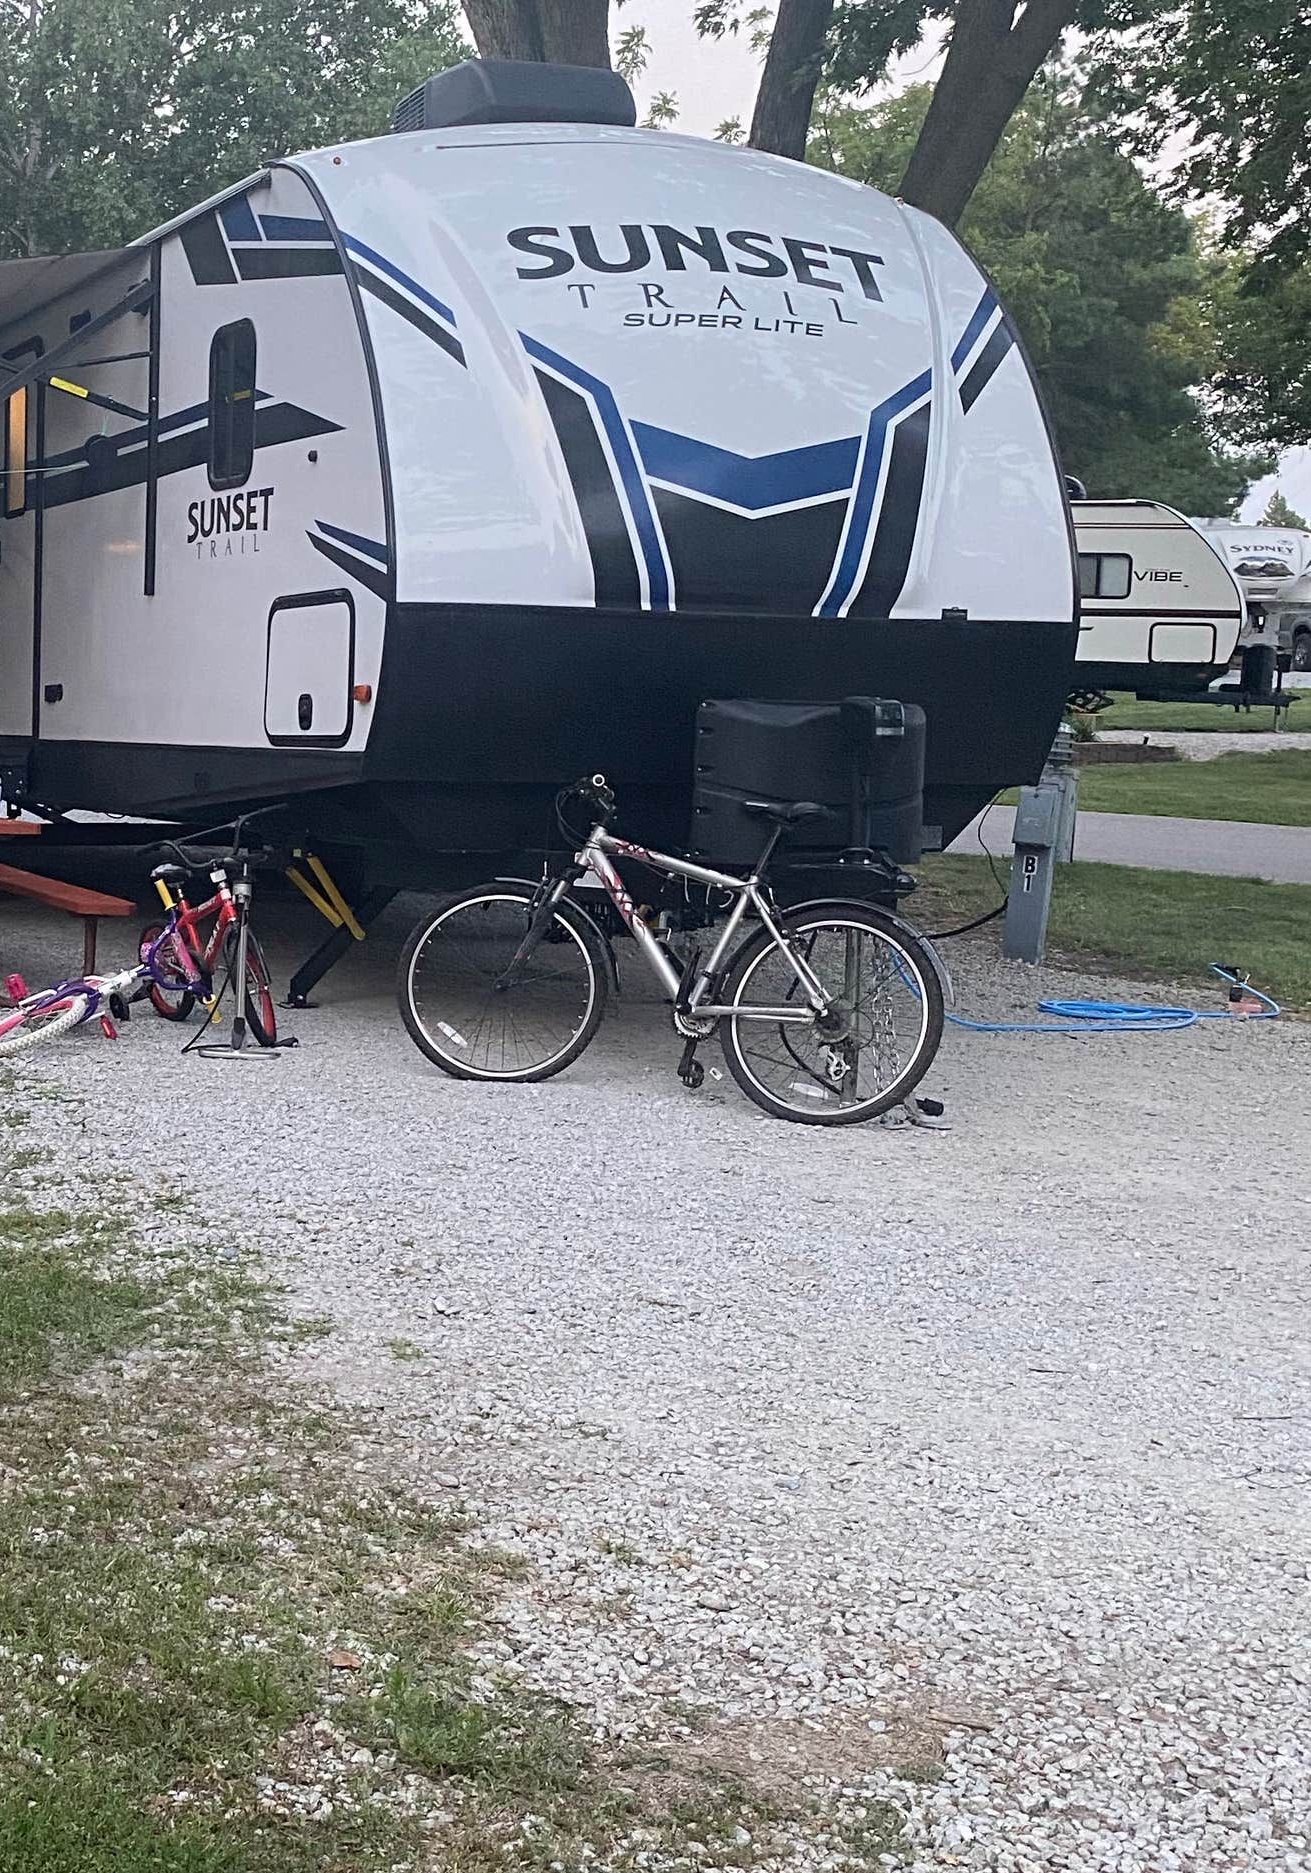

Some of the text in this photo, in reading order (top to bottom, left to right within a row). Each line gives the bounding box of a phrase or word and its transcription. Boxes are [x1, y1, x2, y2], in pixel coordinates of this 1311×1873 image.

[506, 224, 886, 303] SUNSET
[567, 282, 858, 325] TRAIL
[623, 313, 824, 337] SUPER LITE
[187, 487, 274, 544] SUNSET
[196, 533, 260, 559] TRAIL
[1229, 544, 1294, 554] SYDNEY
[1133, 570, 1183, 582] VIBE
